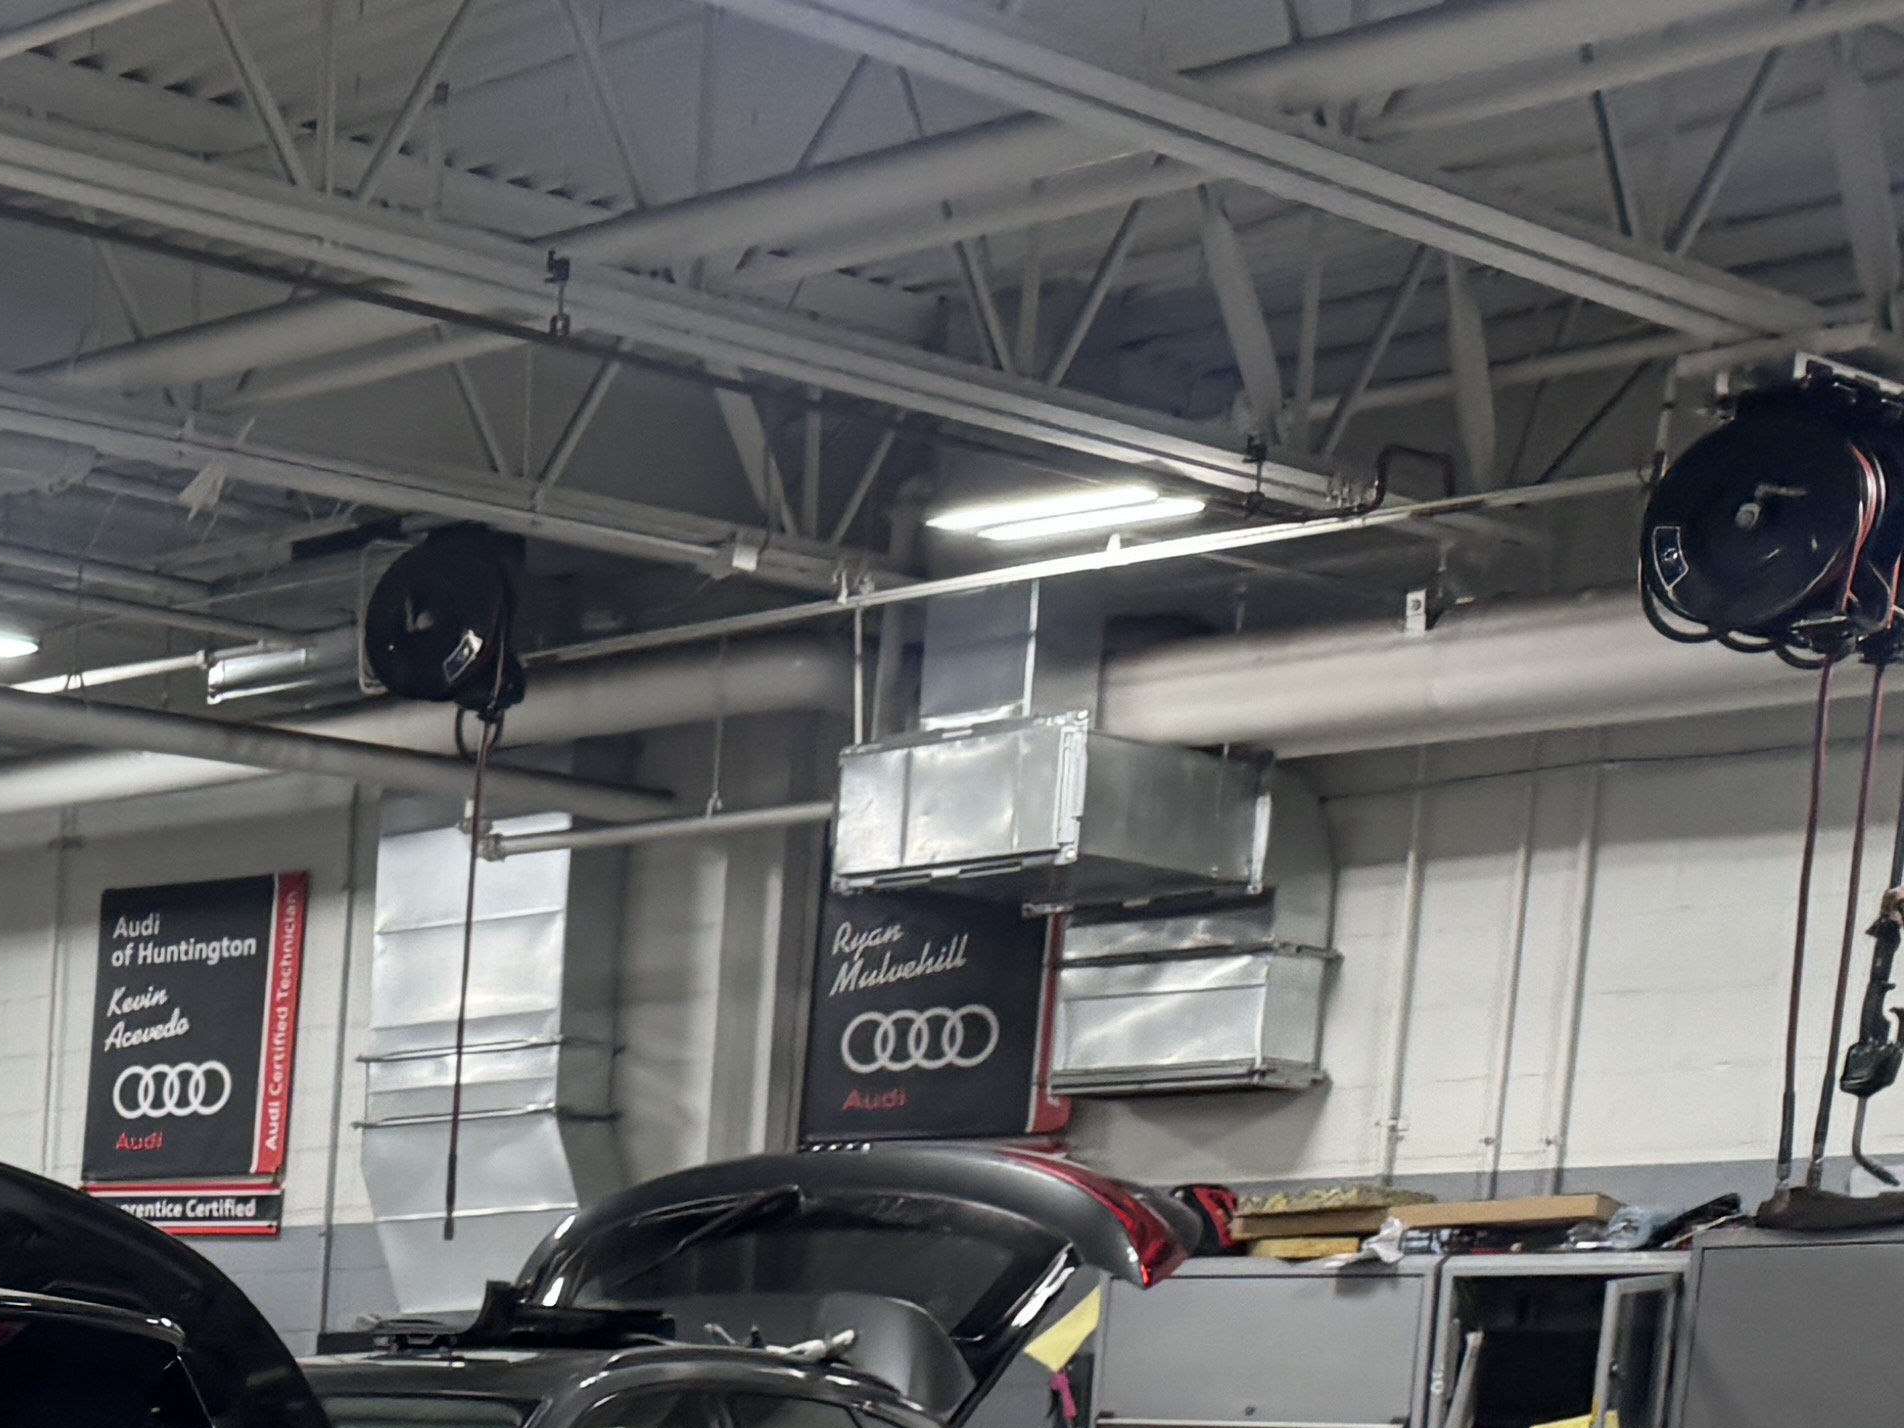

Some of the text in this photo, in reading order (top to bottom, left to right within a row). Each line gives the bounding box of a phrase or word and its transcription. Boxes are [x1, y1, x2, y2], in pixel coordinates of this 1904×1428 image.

[113, 912, 160, 939] Audi
[832, 920, 905, 962] Ryan
[111, 936, 257, 967] of Huntington
[106, 985, 169, 1018] Kevin
[104, 1006, 191, 1053] Acevedo
[268, 1005, 290, 1097] Certified
[843, 1088, 908, 1111] Audi
[115, 1131, 164, 1151] Audi
[265, 1100, 282, 1151] Audi
[185, 1197, 258, 1218] Certified
